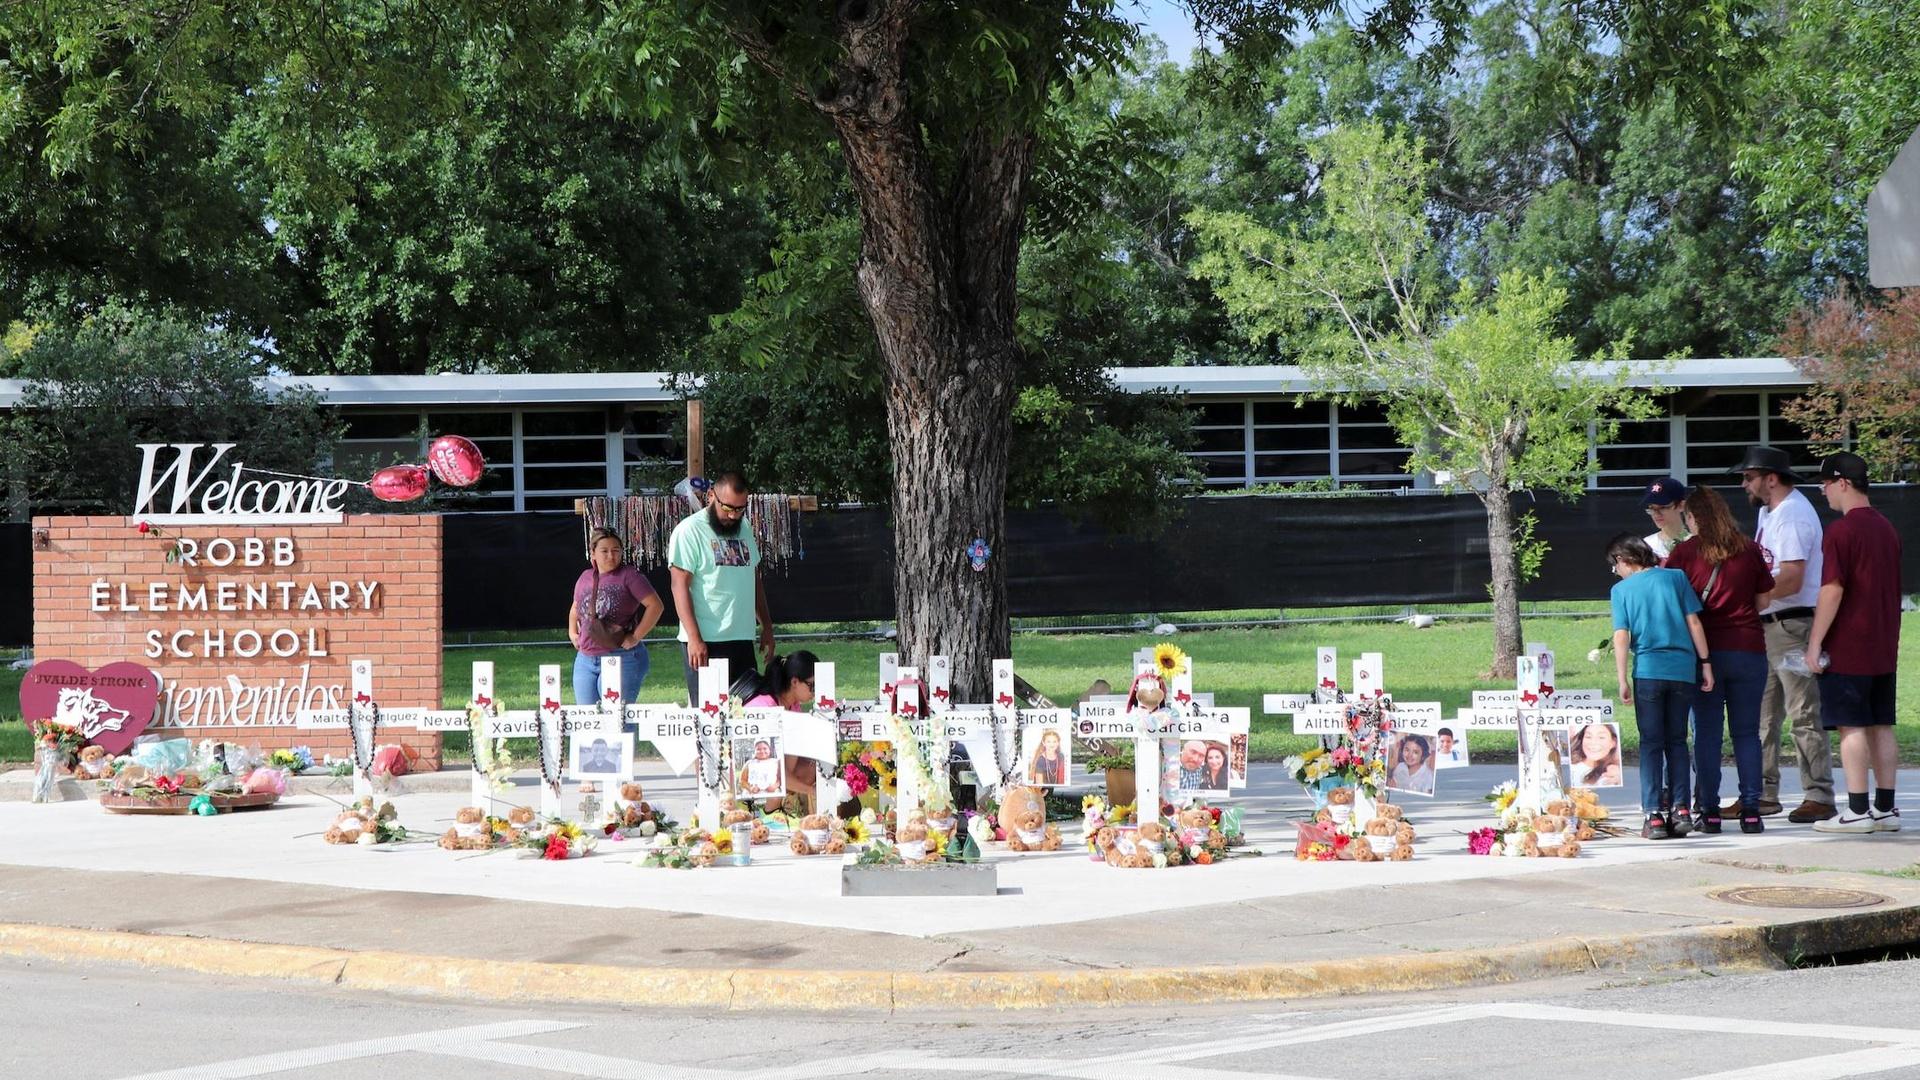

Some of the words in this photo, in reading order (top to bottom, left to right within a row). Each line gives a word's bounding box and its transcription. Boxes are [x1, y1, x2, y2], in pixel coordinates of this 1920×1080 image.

[134, 443, 349, 514] Welcome
[177, 537, 296, 567] ROBB
[91, 580, 379, 612] ELEMENTARY
[145, 627, 328, 658] SCHOOL
[1086, 706, 1116, 717] Mira
[312, 712, 349, 724] Maite
[423, 715, 470, 727] Nevae
[1304, 718, 1344, 729] Alithi
[1470, 714, 1518, 726] Jackie
[1525, 714, 1594, 726] Cazares
[657, 724, 693, 736] Ellie
[702, 724, 760, 737] Garcia
[1095, 722, 1134, 733] Irma
